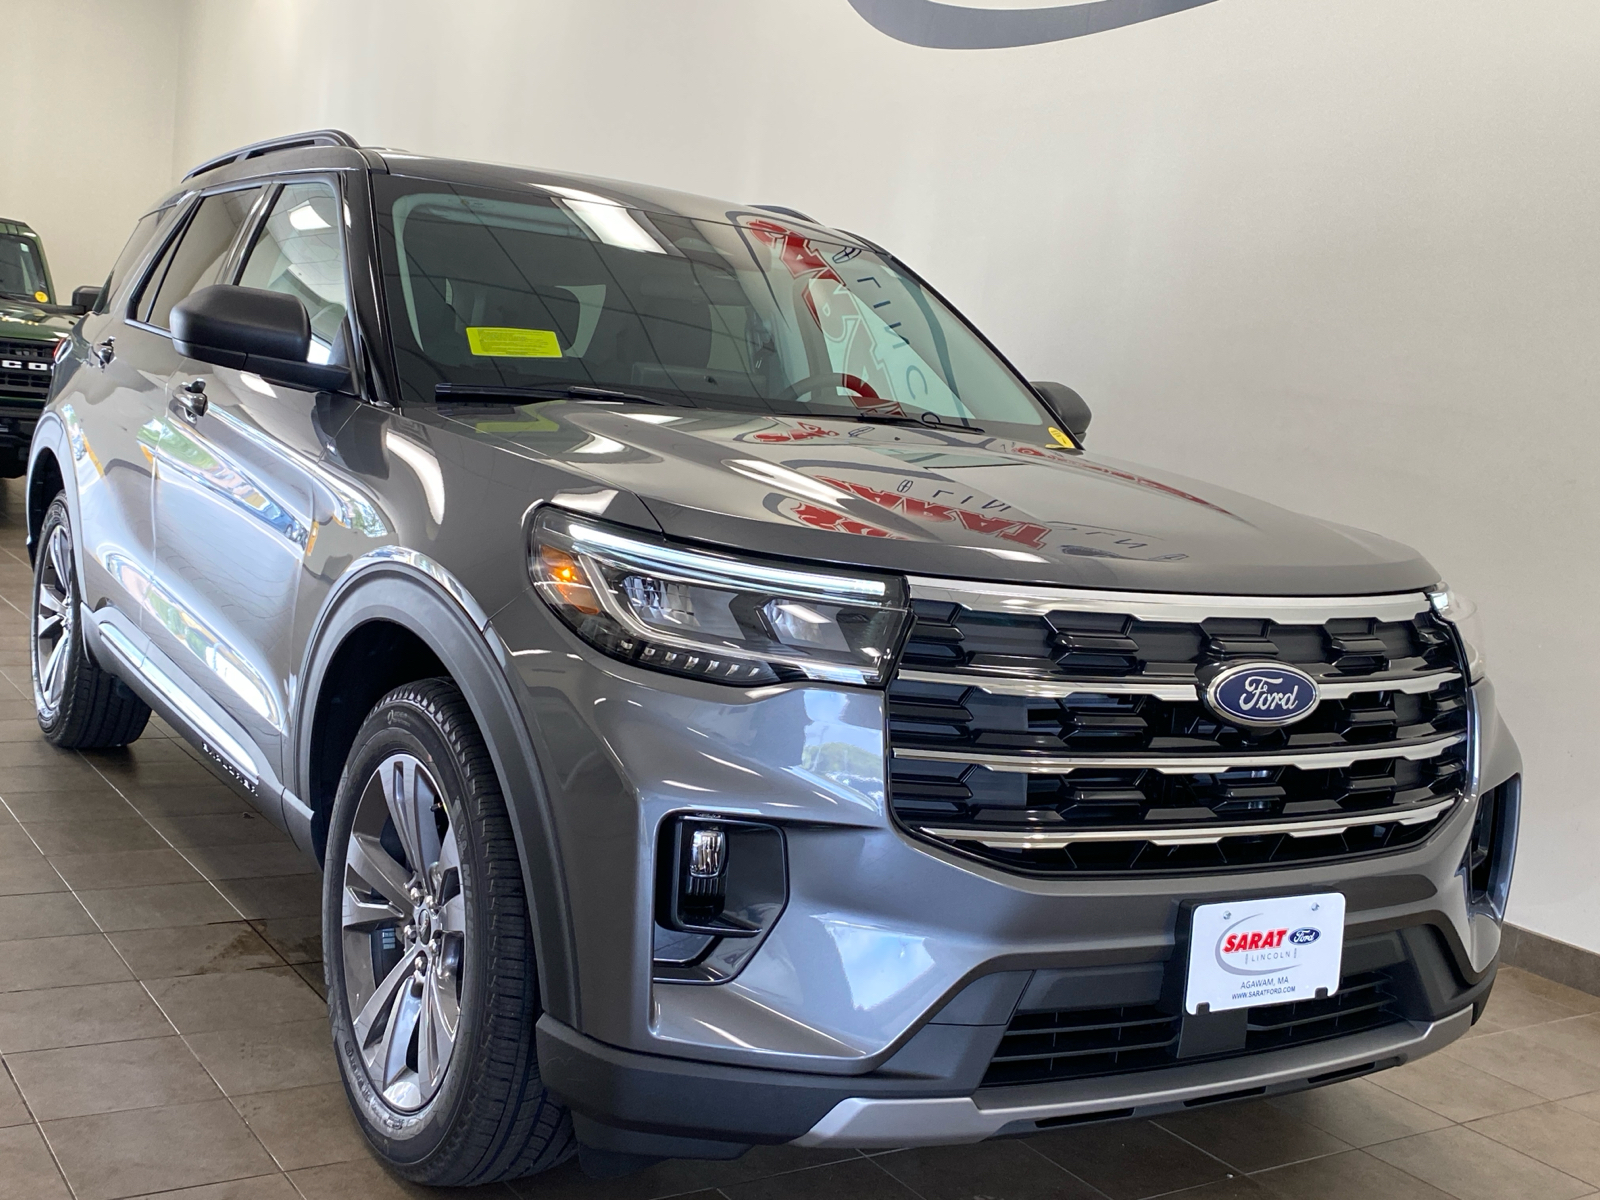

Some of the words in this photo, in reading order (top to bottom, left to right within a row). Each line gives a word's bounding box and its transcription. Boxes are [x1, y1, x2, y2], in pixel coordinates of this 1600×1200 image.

[1239, 675, 1299, 711] Ford
[1222, 928, 1289, 954] SARAT
[1293, 929, 1316, 943] Ford
[1251, 950, 1291, 962] LINCOLN
[1240, 978, 1276, 990] AGAWAM,
[1277, 976, 1290, 985] MA
[1231, 985, 1296, 1000] WWW.SARATFORD.COM
